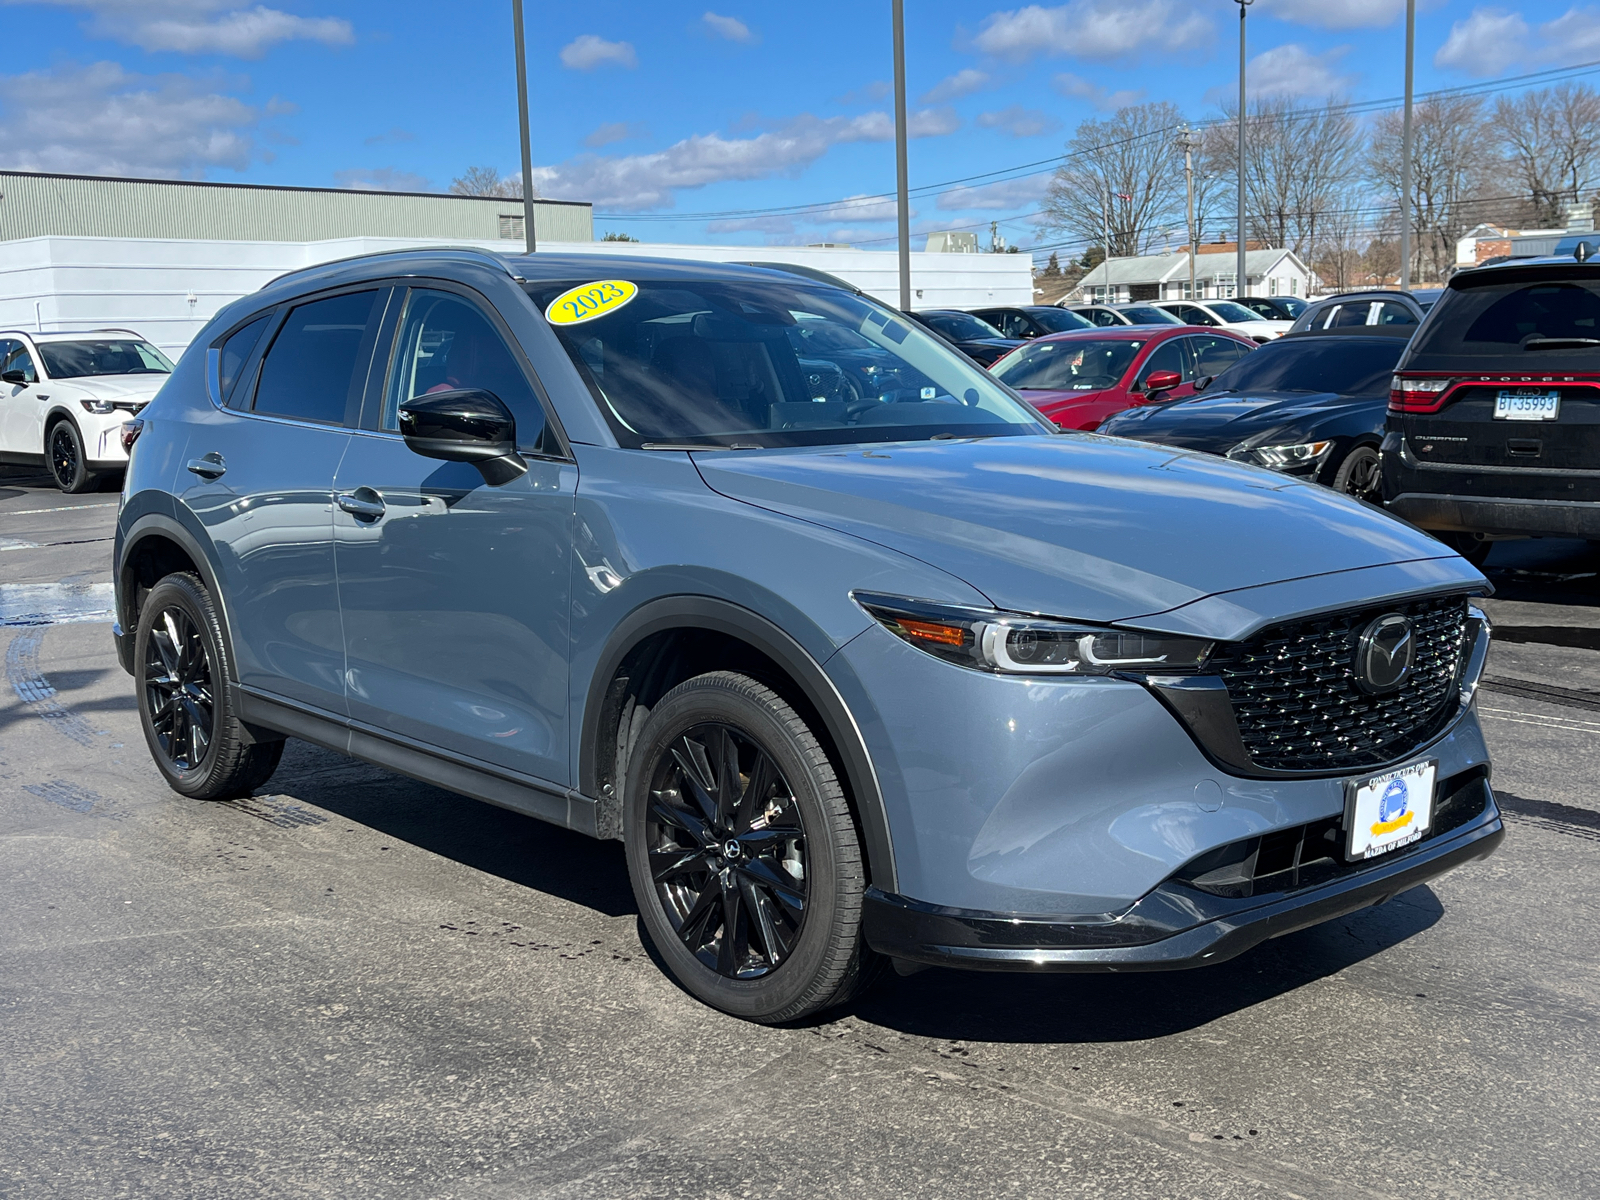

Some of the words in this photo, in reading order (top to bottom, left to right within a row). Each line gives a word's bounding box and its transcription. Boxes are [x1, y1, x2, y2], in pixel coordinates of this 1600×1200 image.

[563, 283, 624, 318] 2023
[1416, 761, 1429, 772] OWN
[1363, 845, 1387, 859] MAZDA
[1388, 841, 1397, 851] OF
[1397, 832, 1422, 847] MILFORD
